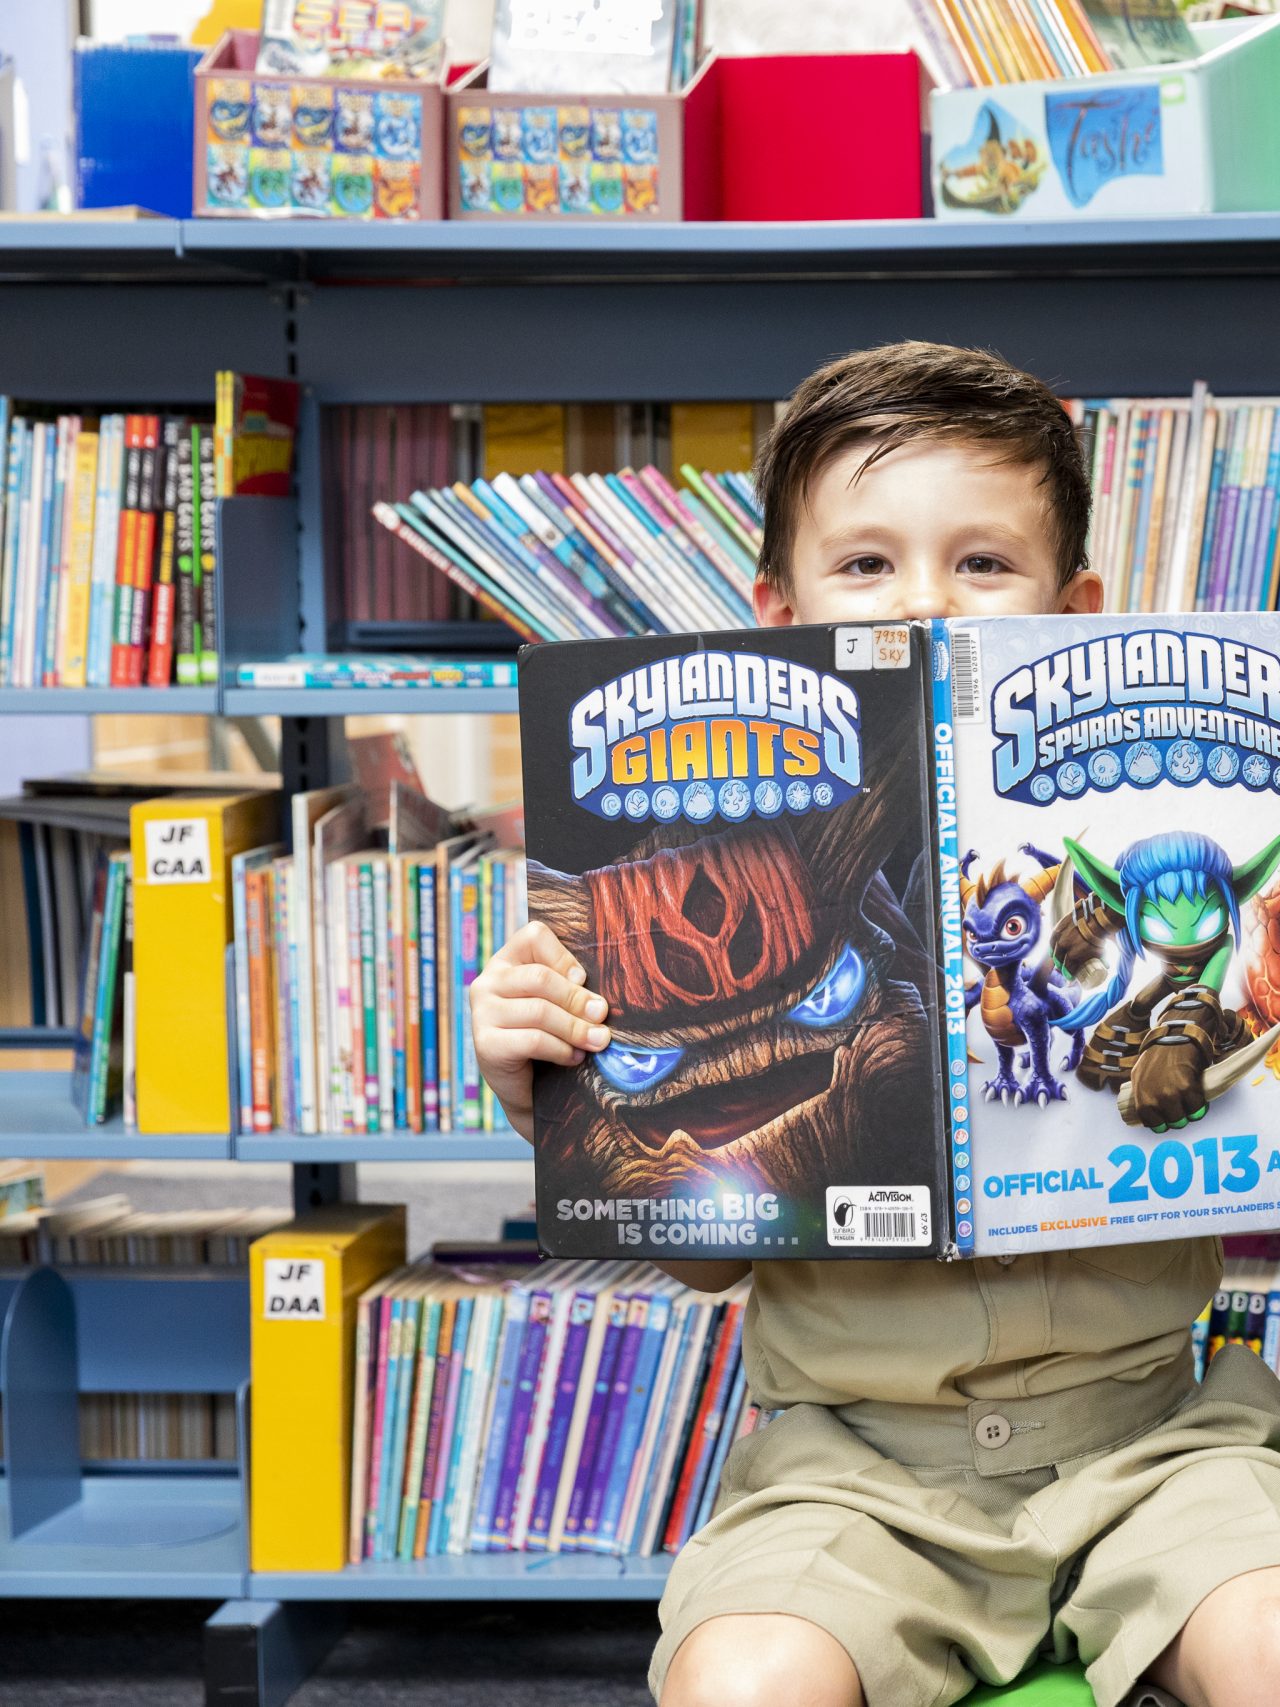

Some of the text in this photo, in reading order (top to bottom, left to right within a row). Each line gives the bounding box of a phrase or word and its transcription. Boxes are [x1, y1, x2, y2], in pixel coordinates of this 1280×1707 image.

[846, 638, 858, 654] J
[879, 648, 905, 667] SKY
[571, 652, 862, 800] SKYLANDERS
[1038, 707, 1141, 768] SPYRO'S
[611, 719, 821, 786] GIANTS
[161, 825, 193, 843] JF
[153, 859, 203, 876] CAA
[934, 722, 965, 1035] OFFICIAL ANNUAL 2013
[983, 1167, 1104, 1199] OFFICIAL
[1107, 1134, 1261, 1204] 2013
[556, 1193, 779, 1222] SOMETHING BIG
[988, 1223, 1039, 1237] INCLUDES
[1040, 1215, 1108, 1231] EXCLUSIVE
[1110, 1214, 1135, 1225] FREE
[1137, 1212, 1159, 1223] GIFT
[1160, 1210, 1181, 1220] FOR
[1182, 1207, 1210, 1219] YOUR
[1211, 1201, 1275, 1216] SKYLANDERS
[617, 1223, 757, 1245] IS COMING
[279, 1264, 311, 1280] JF
[270, 1296, 320, 1312] DAA
